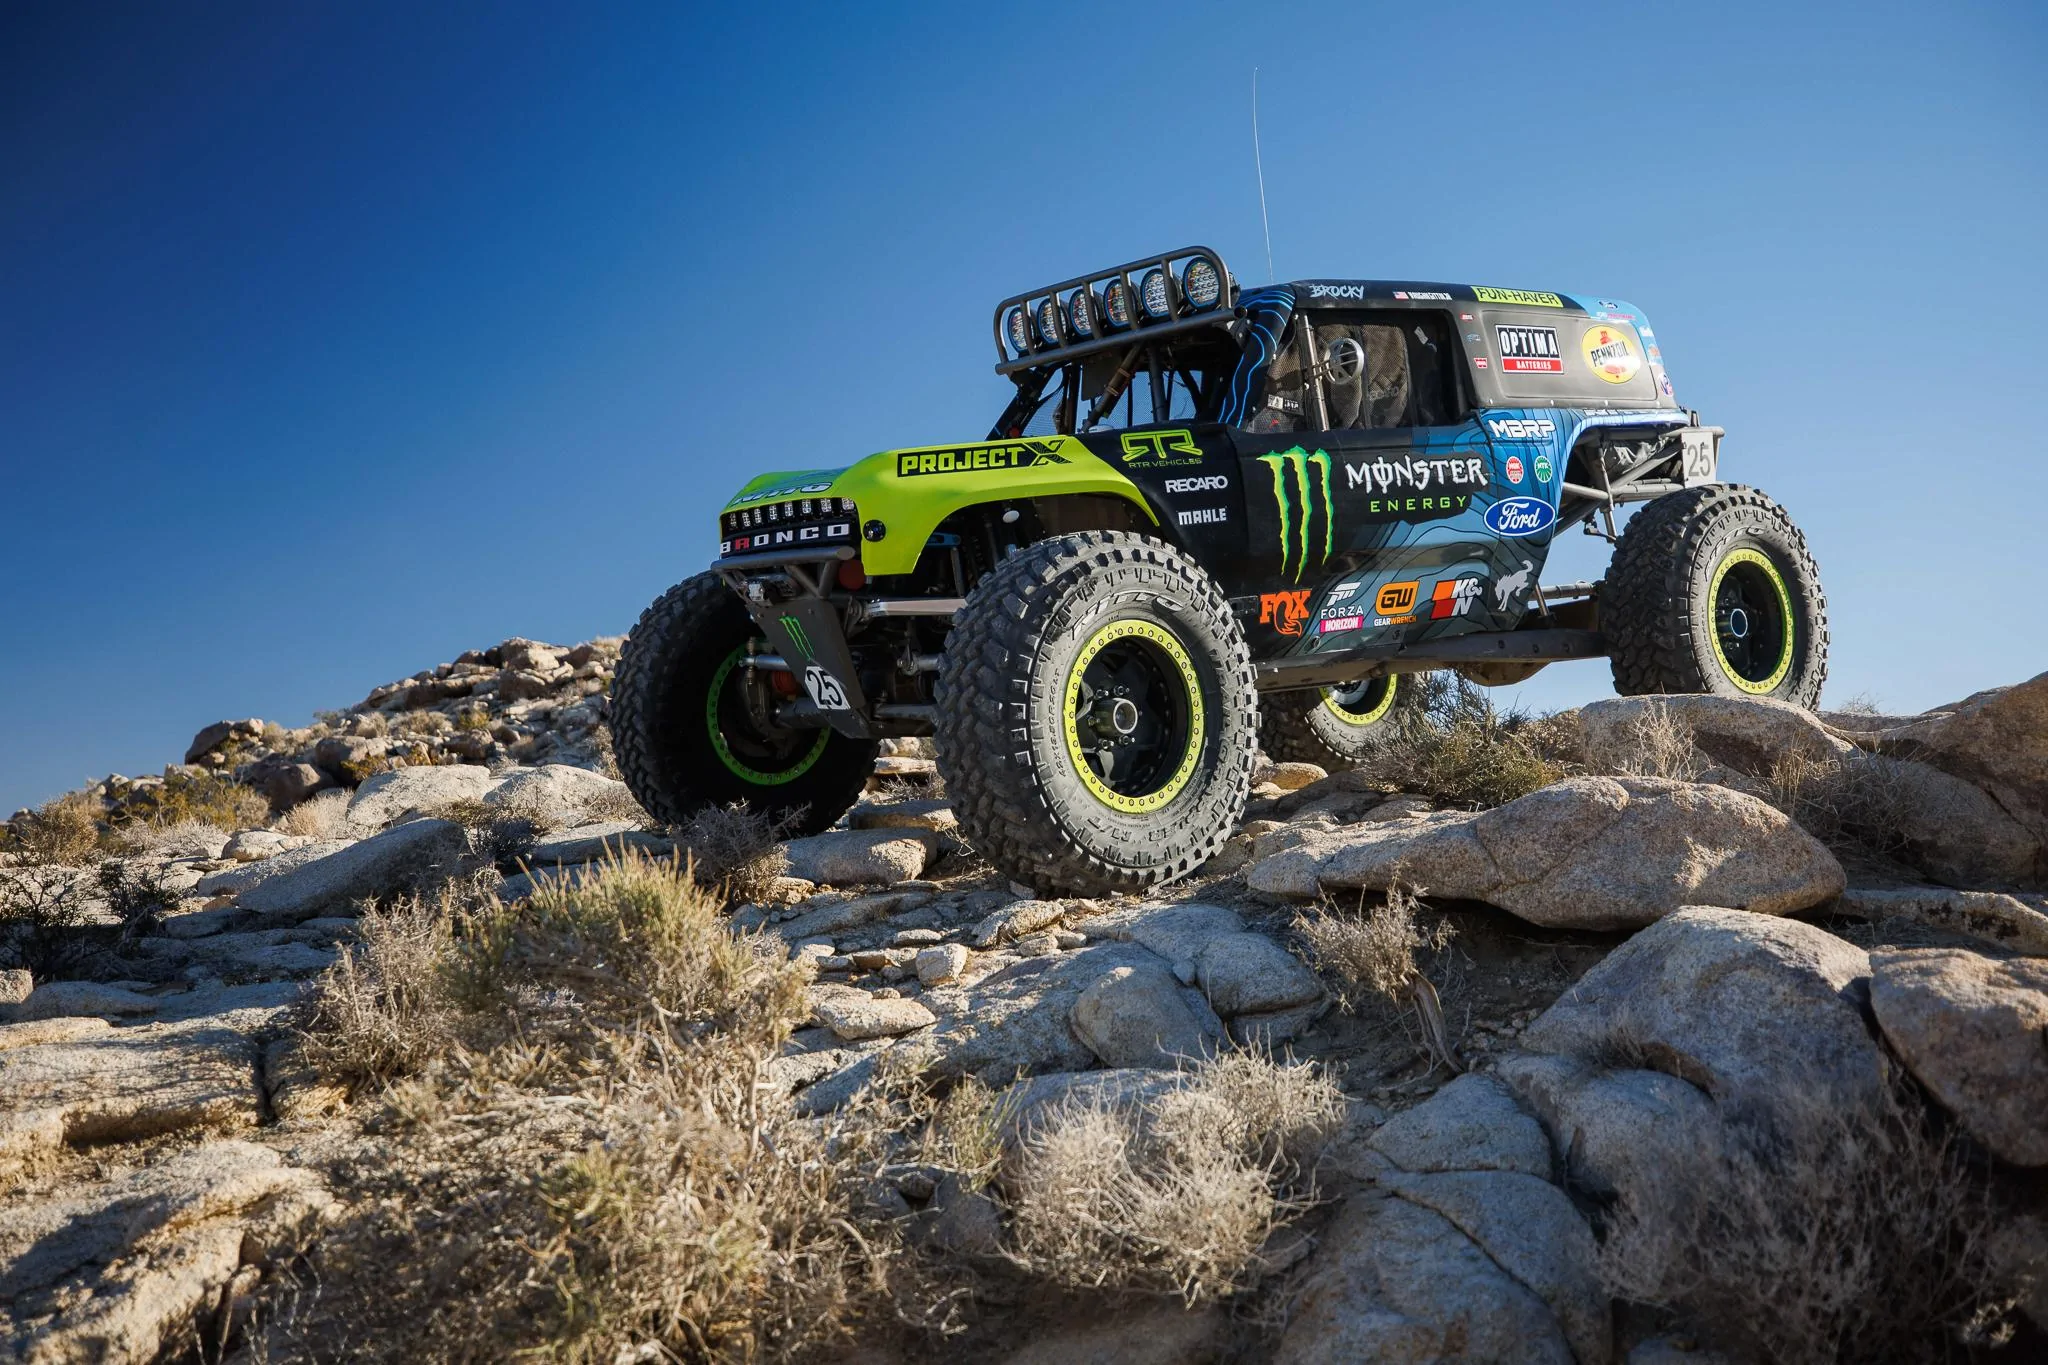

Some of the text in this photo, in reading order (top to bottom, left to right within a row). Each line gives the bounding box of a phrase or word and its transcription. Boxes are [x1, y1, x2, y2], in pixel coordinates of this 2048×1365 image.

[1309, 284, 1364, 300] BROCKY
[1476, 287, 1558, 306] FUN-HAVER
[1500, 331, 1557, 356] OPTIMA
[1516, 360, 1552, 371] BATTERIES
[1488, 419, 1556, 439] MBRP
[901, 447, 1026, 475] PROJECT
[1152, 457, 1203, 467] VEHICLES
[1687, 442, 1711, 478] 25
[1165, 475, 1228, 493] RECARO
[1345, 455, 1488, 494] MONSTER
[1370, 495, 1467, 513] ENERGY
[1178, 508, 1227, 526] MAHLE
[1498, 502, 1541, 530] Ford
[720, 523, 850, 554] BRONCO
[1260, 590, 1311, 637] FOX
[1321, 605, 1364, 619] FORZA
[1374, 614, 1417, 627] GEARWRENCH
[1325, 617, 1359, 632] HORIZON
[806, 669, 843, 707] 25
